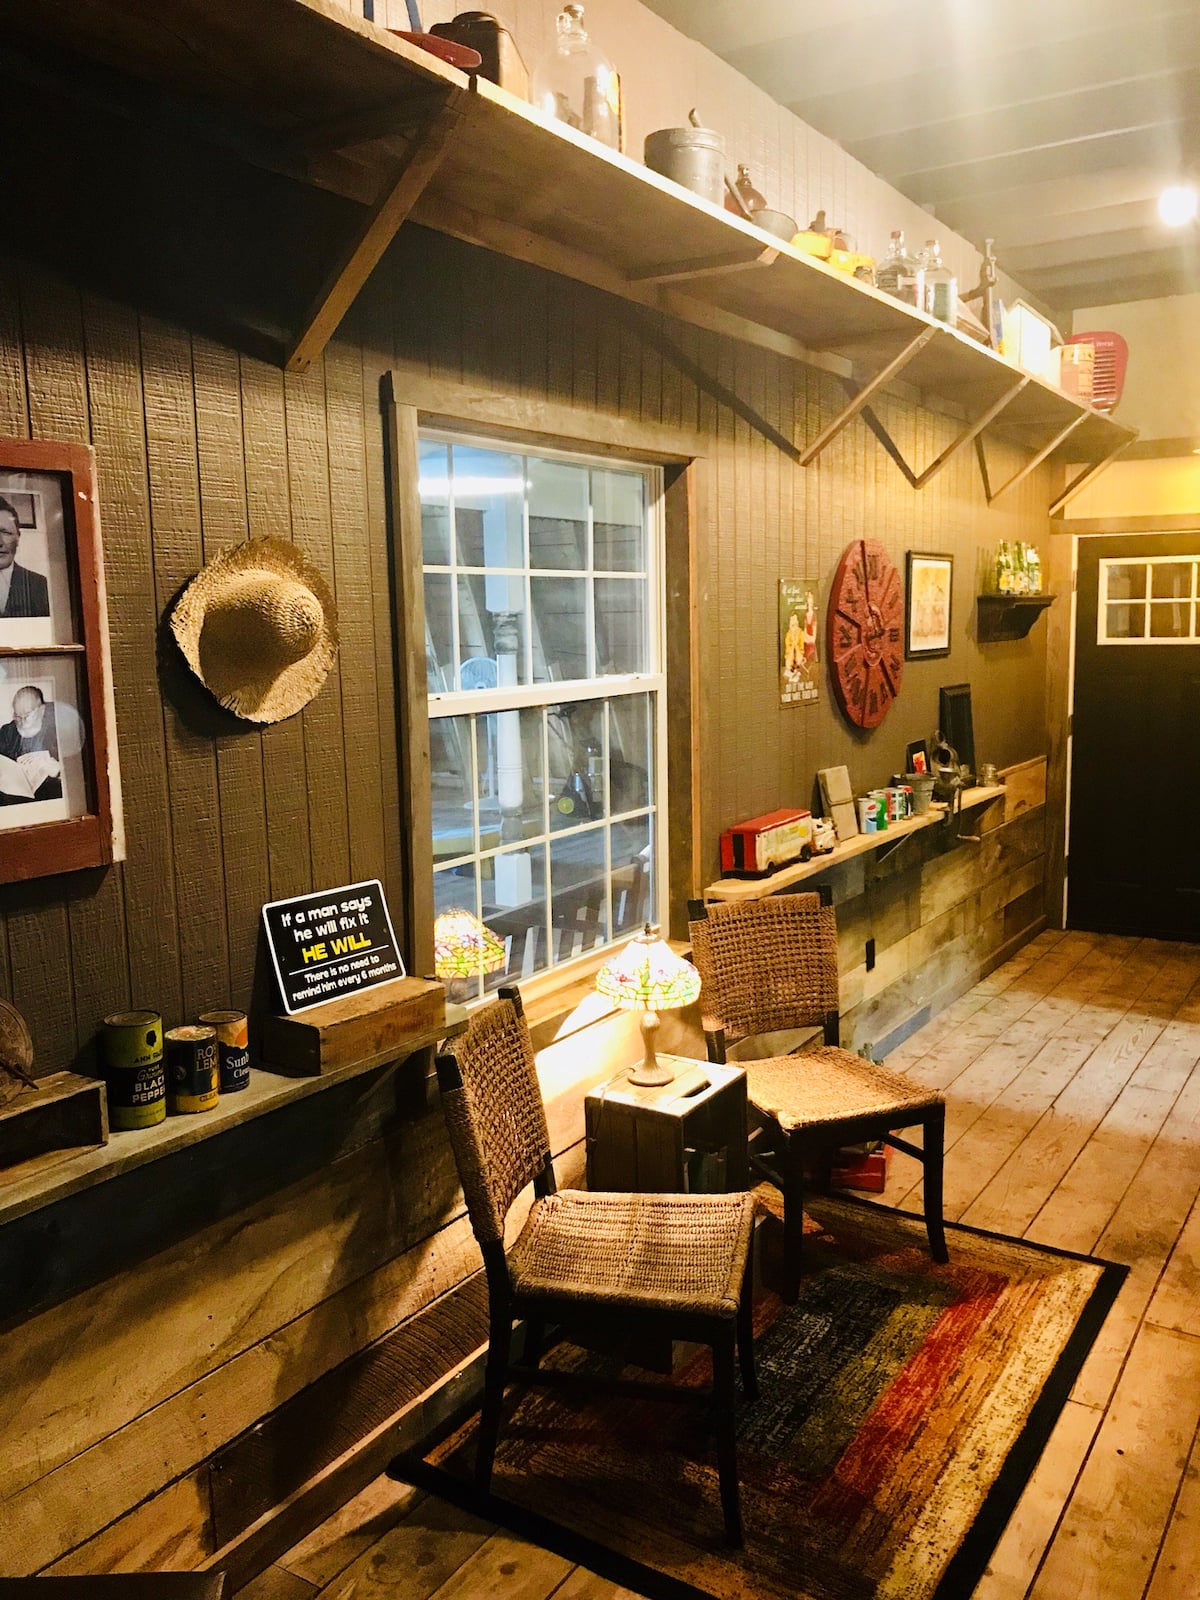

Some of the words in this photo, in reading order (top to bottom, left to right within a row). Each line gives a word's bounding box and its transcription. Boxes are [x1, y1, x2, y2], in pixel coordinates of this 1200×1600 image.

[281, 913, 292, 927] If
[295, 913, 305, 923] a
[308, 905, 338, 921] man
[340, 896, 372, 912] says
[294, 928, 312, 942] he
[316, 921, 337, 936] will
[339, 916, 357, 930] fix
[358, 913, 369, 925] it
[302, 943, 328, 963] HE
[330, 932, 371, 955] WILL
[293, 985, 321, 1001] remind
[322, 981, 337, 993] him
[338, 974, 361, 987] every
[362, 969, 367, 978] 6
[368, 962, 397, 978] months
[304, 970, 329, 983] There
[330, 967, 337, 976] is
[339, 964, 349, 974] no
[351, 956, 369, 970] need
[370, 955, 379, 964] to
